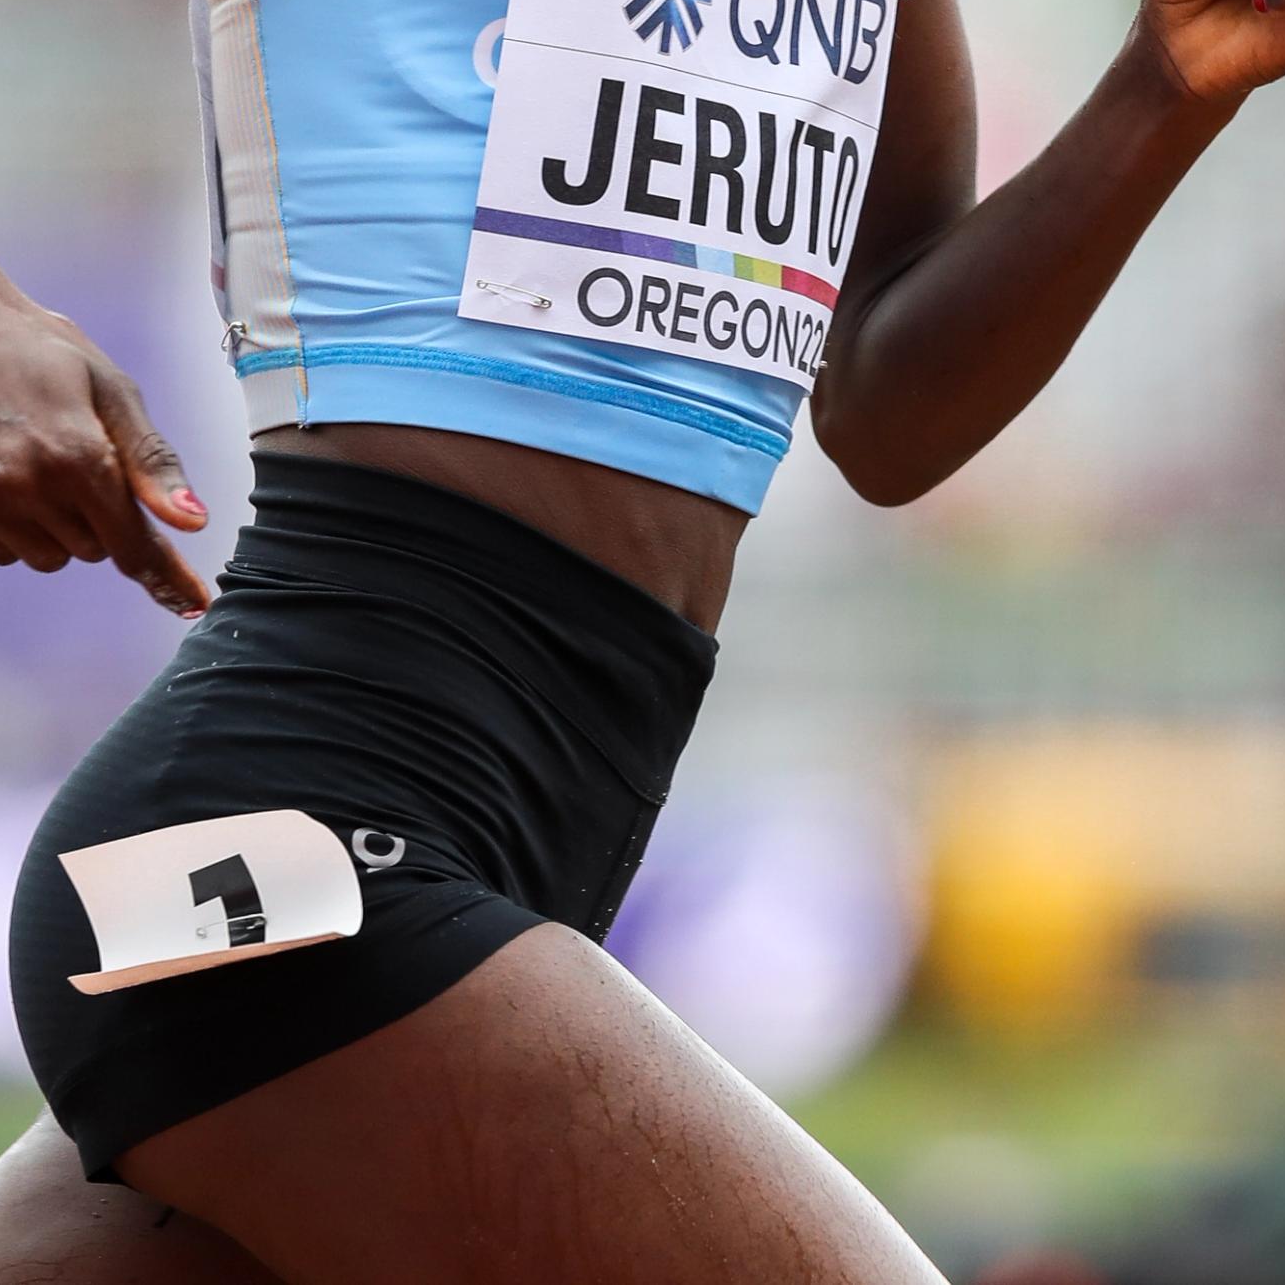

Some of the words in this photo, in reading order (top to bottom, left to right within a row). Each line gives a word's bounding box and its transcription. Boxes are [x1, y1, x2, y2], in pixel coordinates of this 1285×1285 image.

[541, 78, 859, 267] JERUTO
[577, 267, 824, 378] OREGON22
[188, 853, 267, 948] 1
